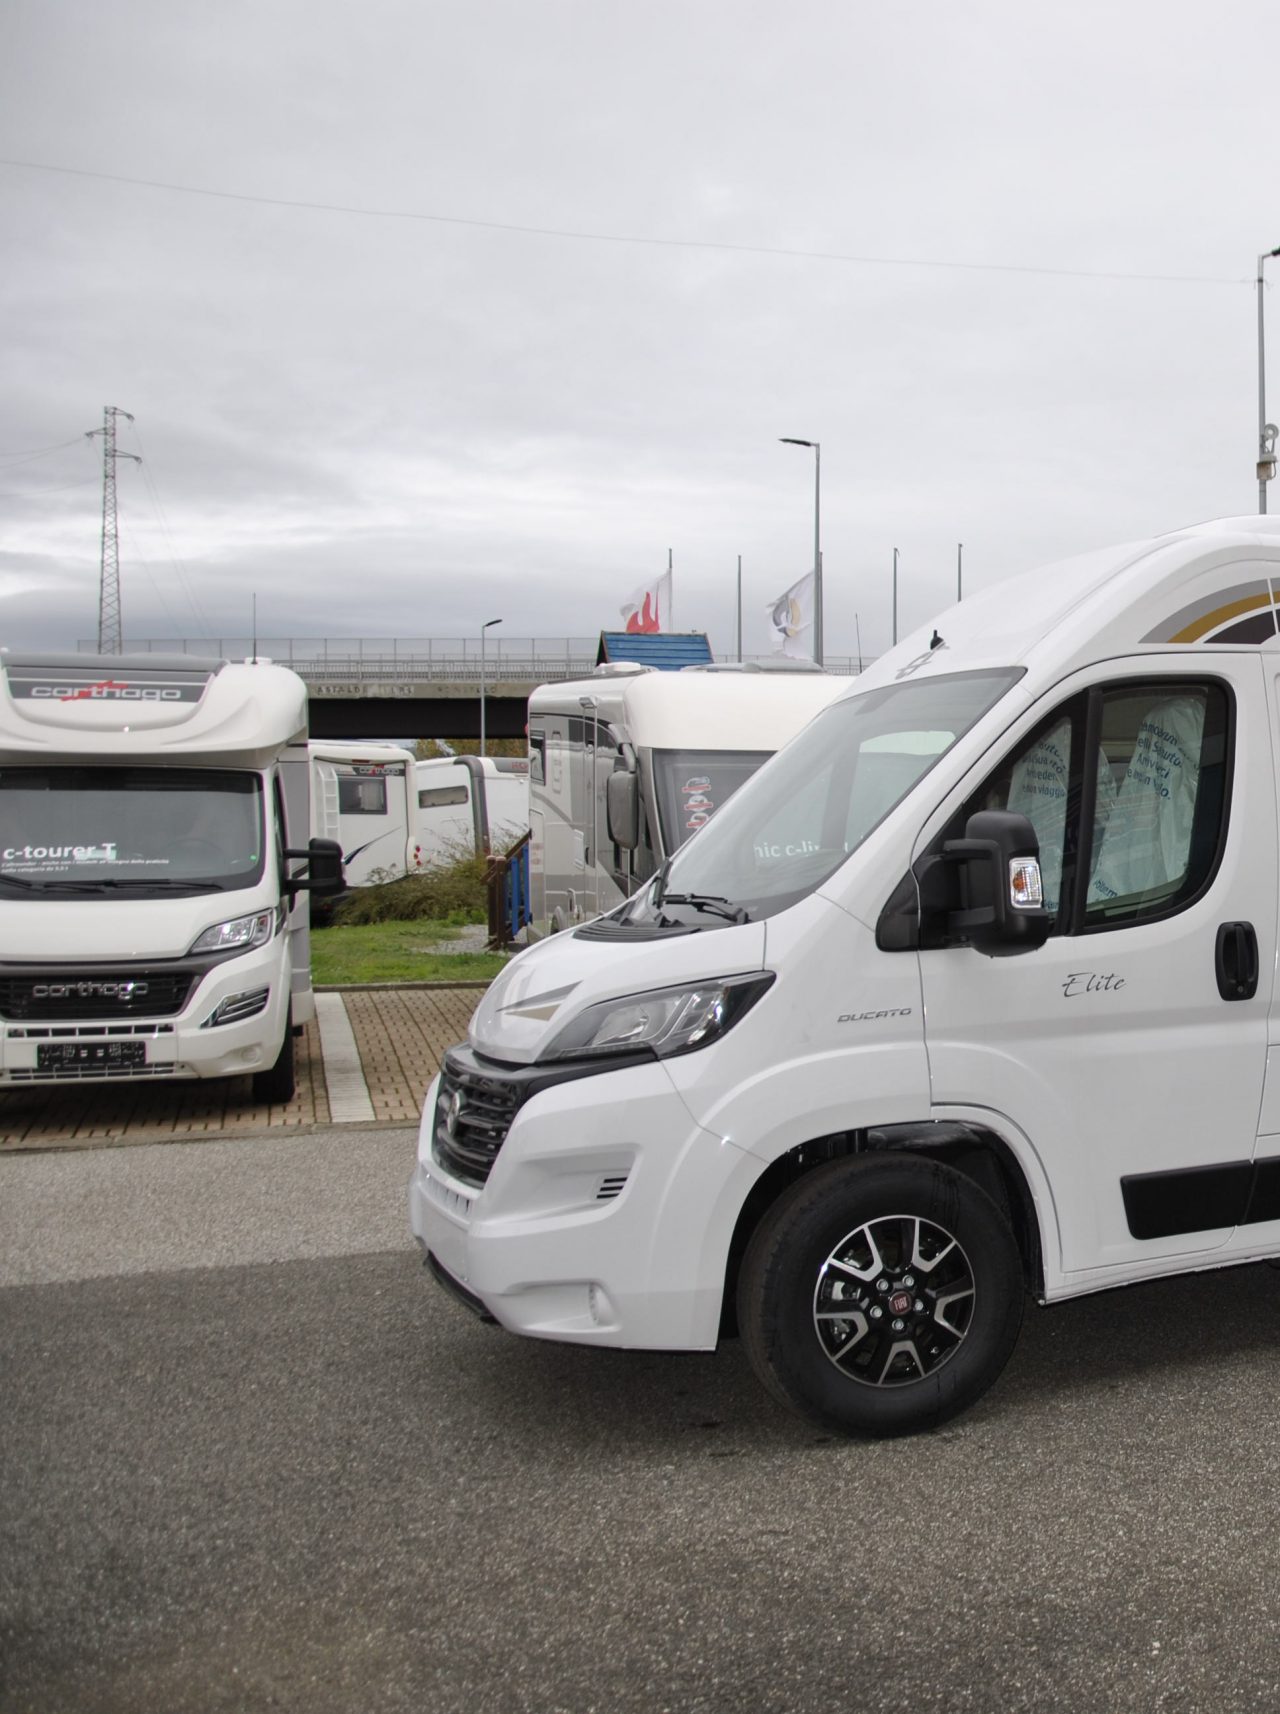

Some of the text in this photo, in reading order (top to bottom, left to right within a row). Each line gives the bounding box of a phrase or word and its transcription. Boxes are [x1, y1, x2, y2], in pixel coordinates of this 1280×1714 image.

[31, 686, 181, 701] carthago
[3, 843, 116, 860] c-tourer T
[33, 981, 149, 999] carthago
[1062, 971, 1127, 998] Elite
[837, 1007, 912, 1023] DUCATO
